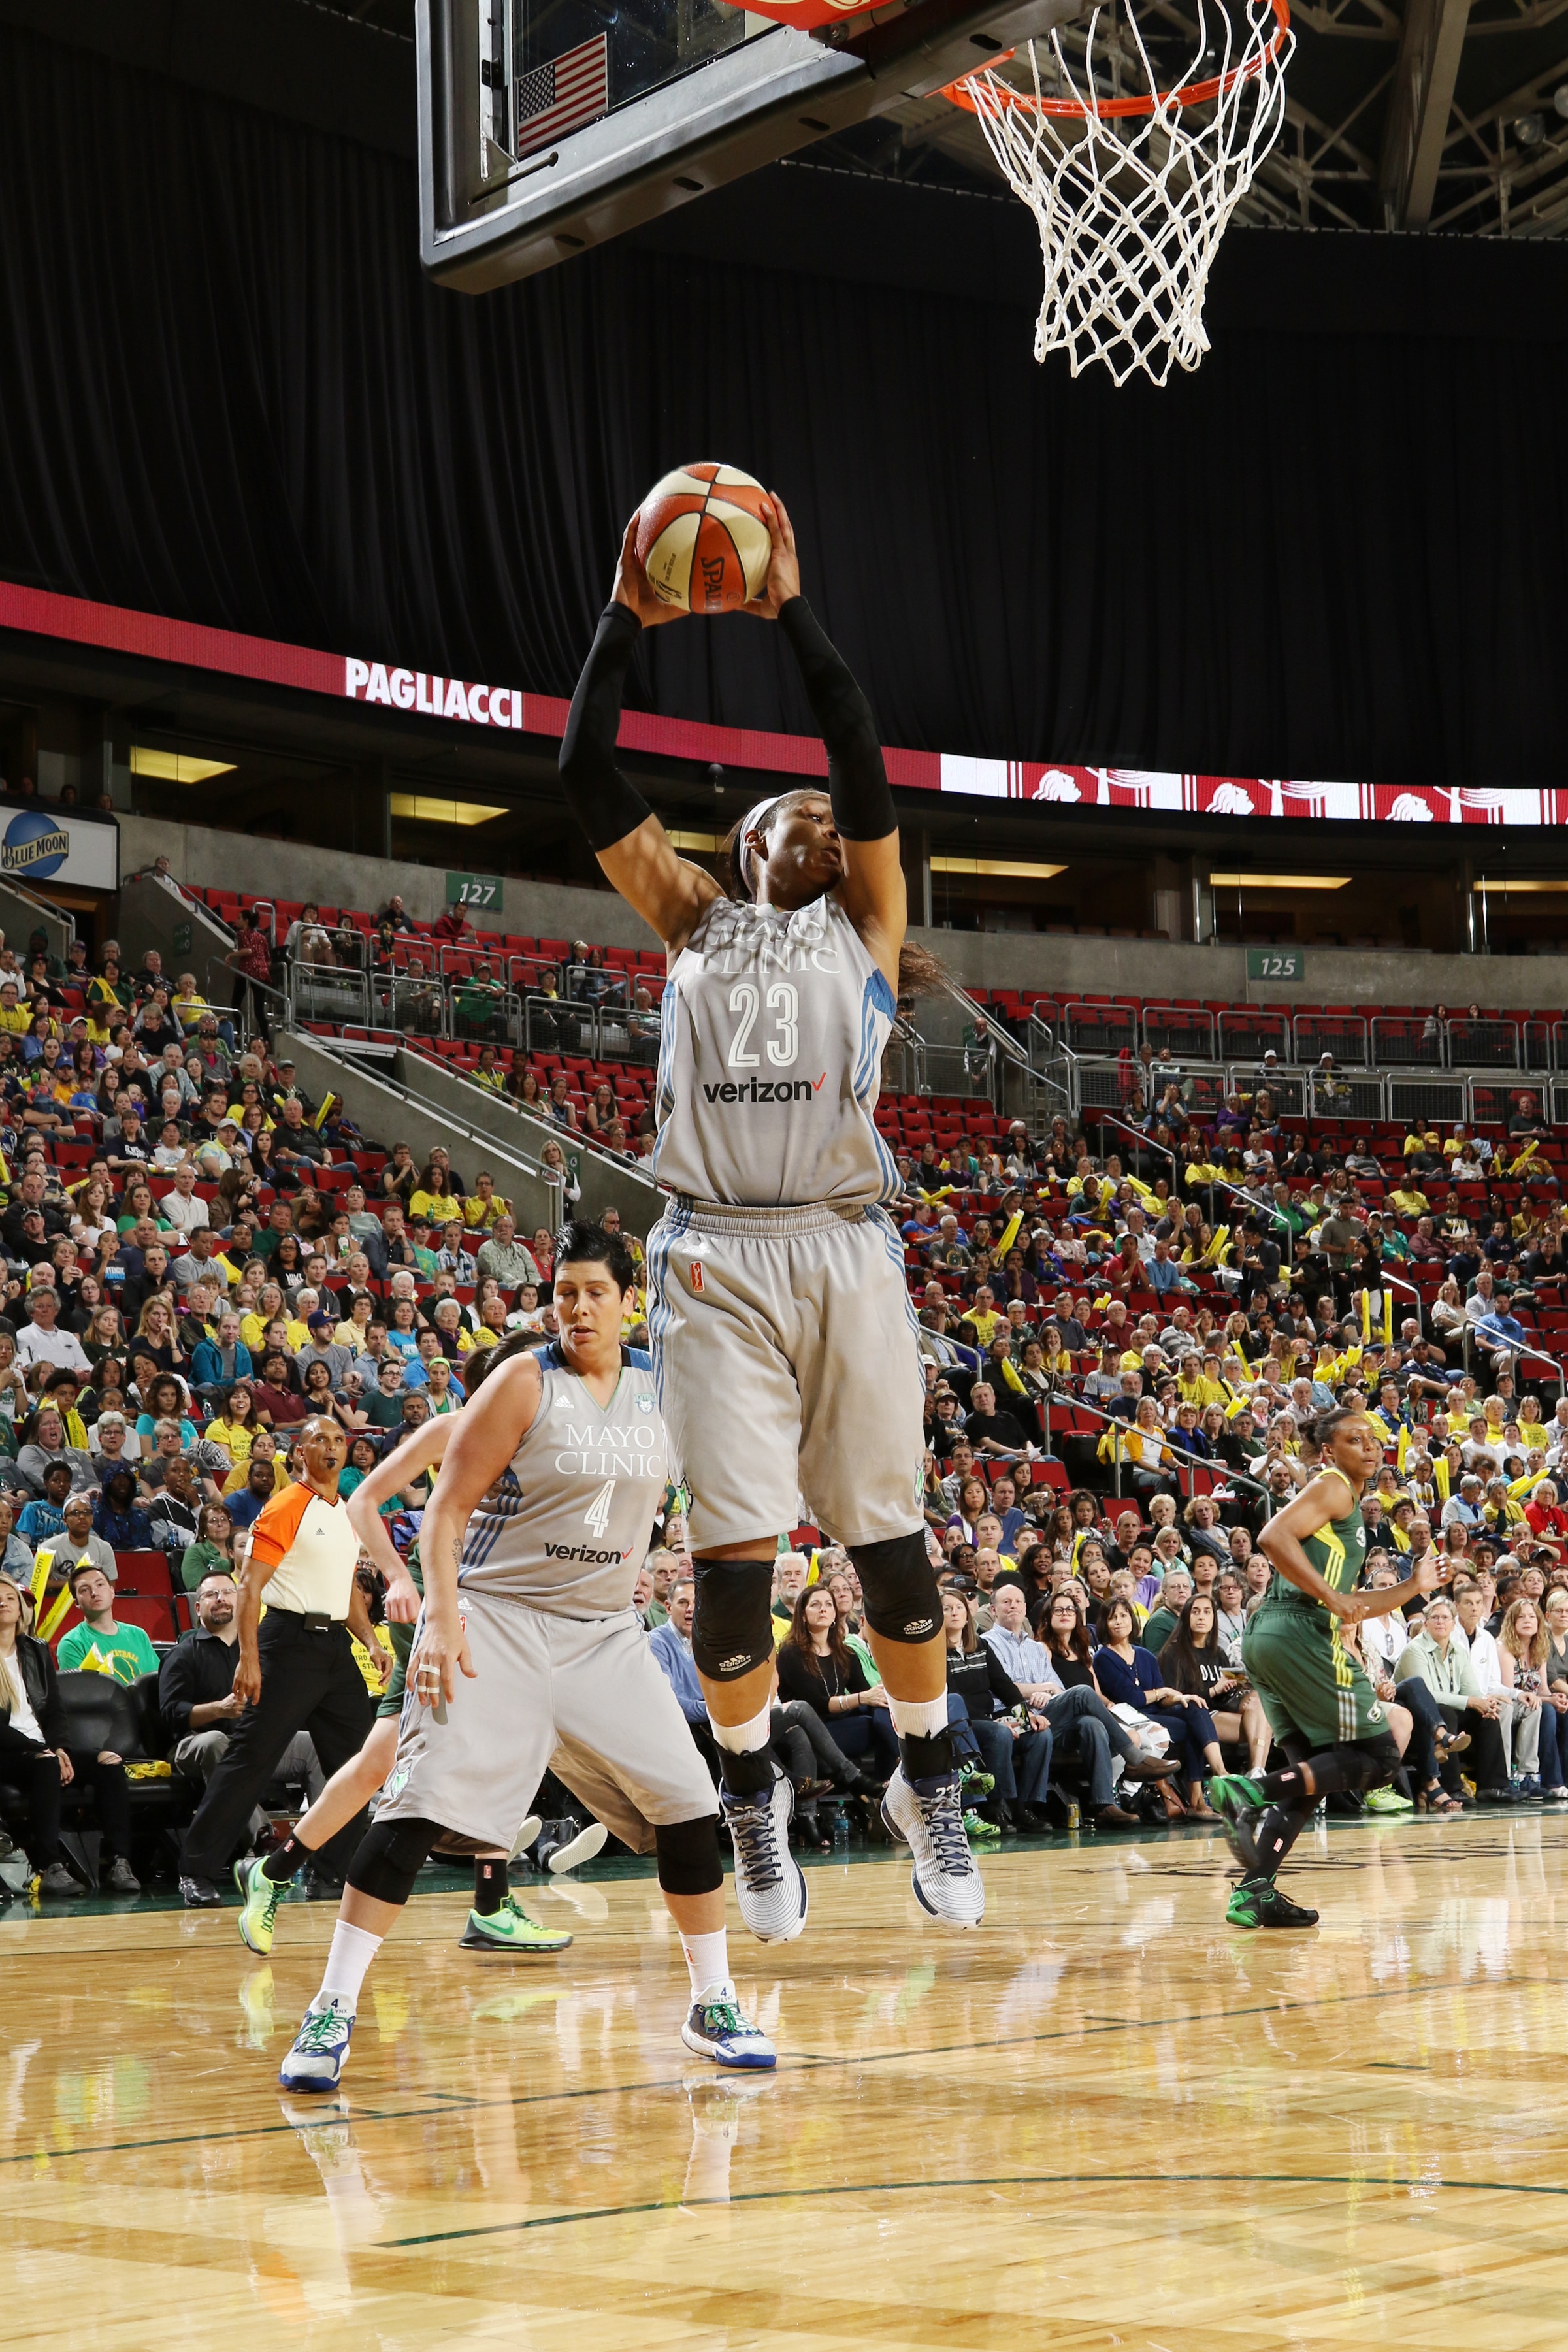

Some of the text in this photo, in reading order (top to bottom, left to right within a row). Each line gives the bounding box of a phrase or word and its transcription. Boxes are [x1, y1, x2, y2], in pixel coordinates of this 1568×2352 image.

[346, 656, 523, 729] PAGLIACCI
[473, 877, 496, 886] Section
[461, 883, 496, 905] 127
[694, 945, 840, 975] CLINIC
[1262, 958, 1296, 976] 125
[728, 982, 799, 1068] 23
[703, 1077, 812, 1103] verizon
[565, 1424, 655, 1448] MAYO
[555, 1451, 661, 1478] CLINIC
[583, 1479, 616, 1539] 4
[544, 1543, 621, 1565] verizon
[903, 1618, 932, 1631] adidas
[719, 1654, 751, 1667] adidas
[331, 1998, 338, 2008] 4
[720, 1987, 727, 1997] 4
